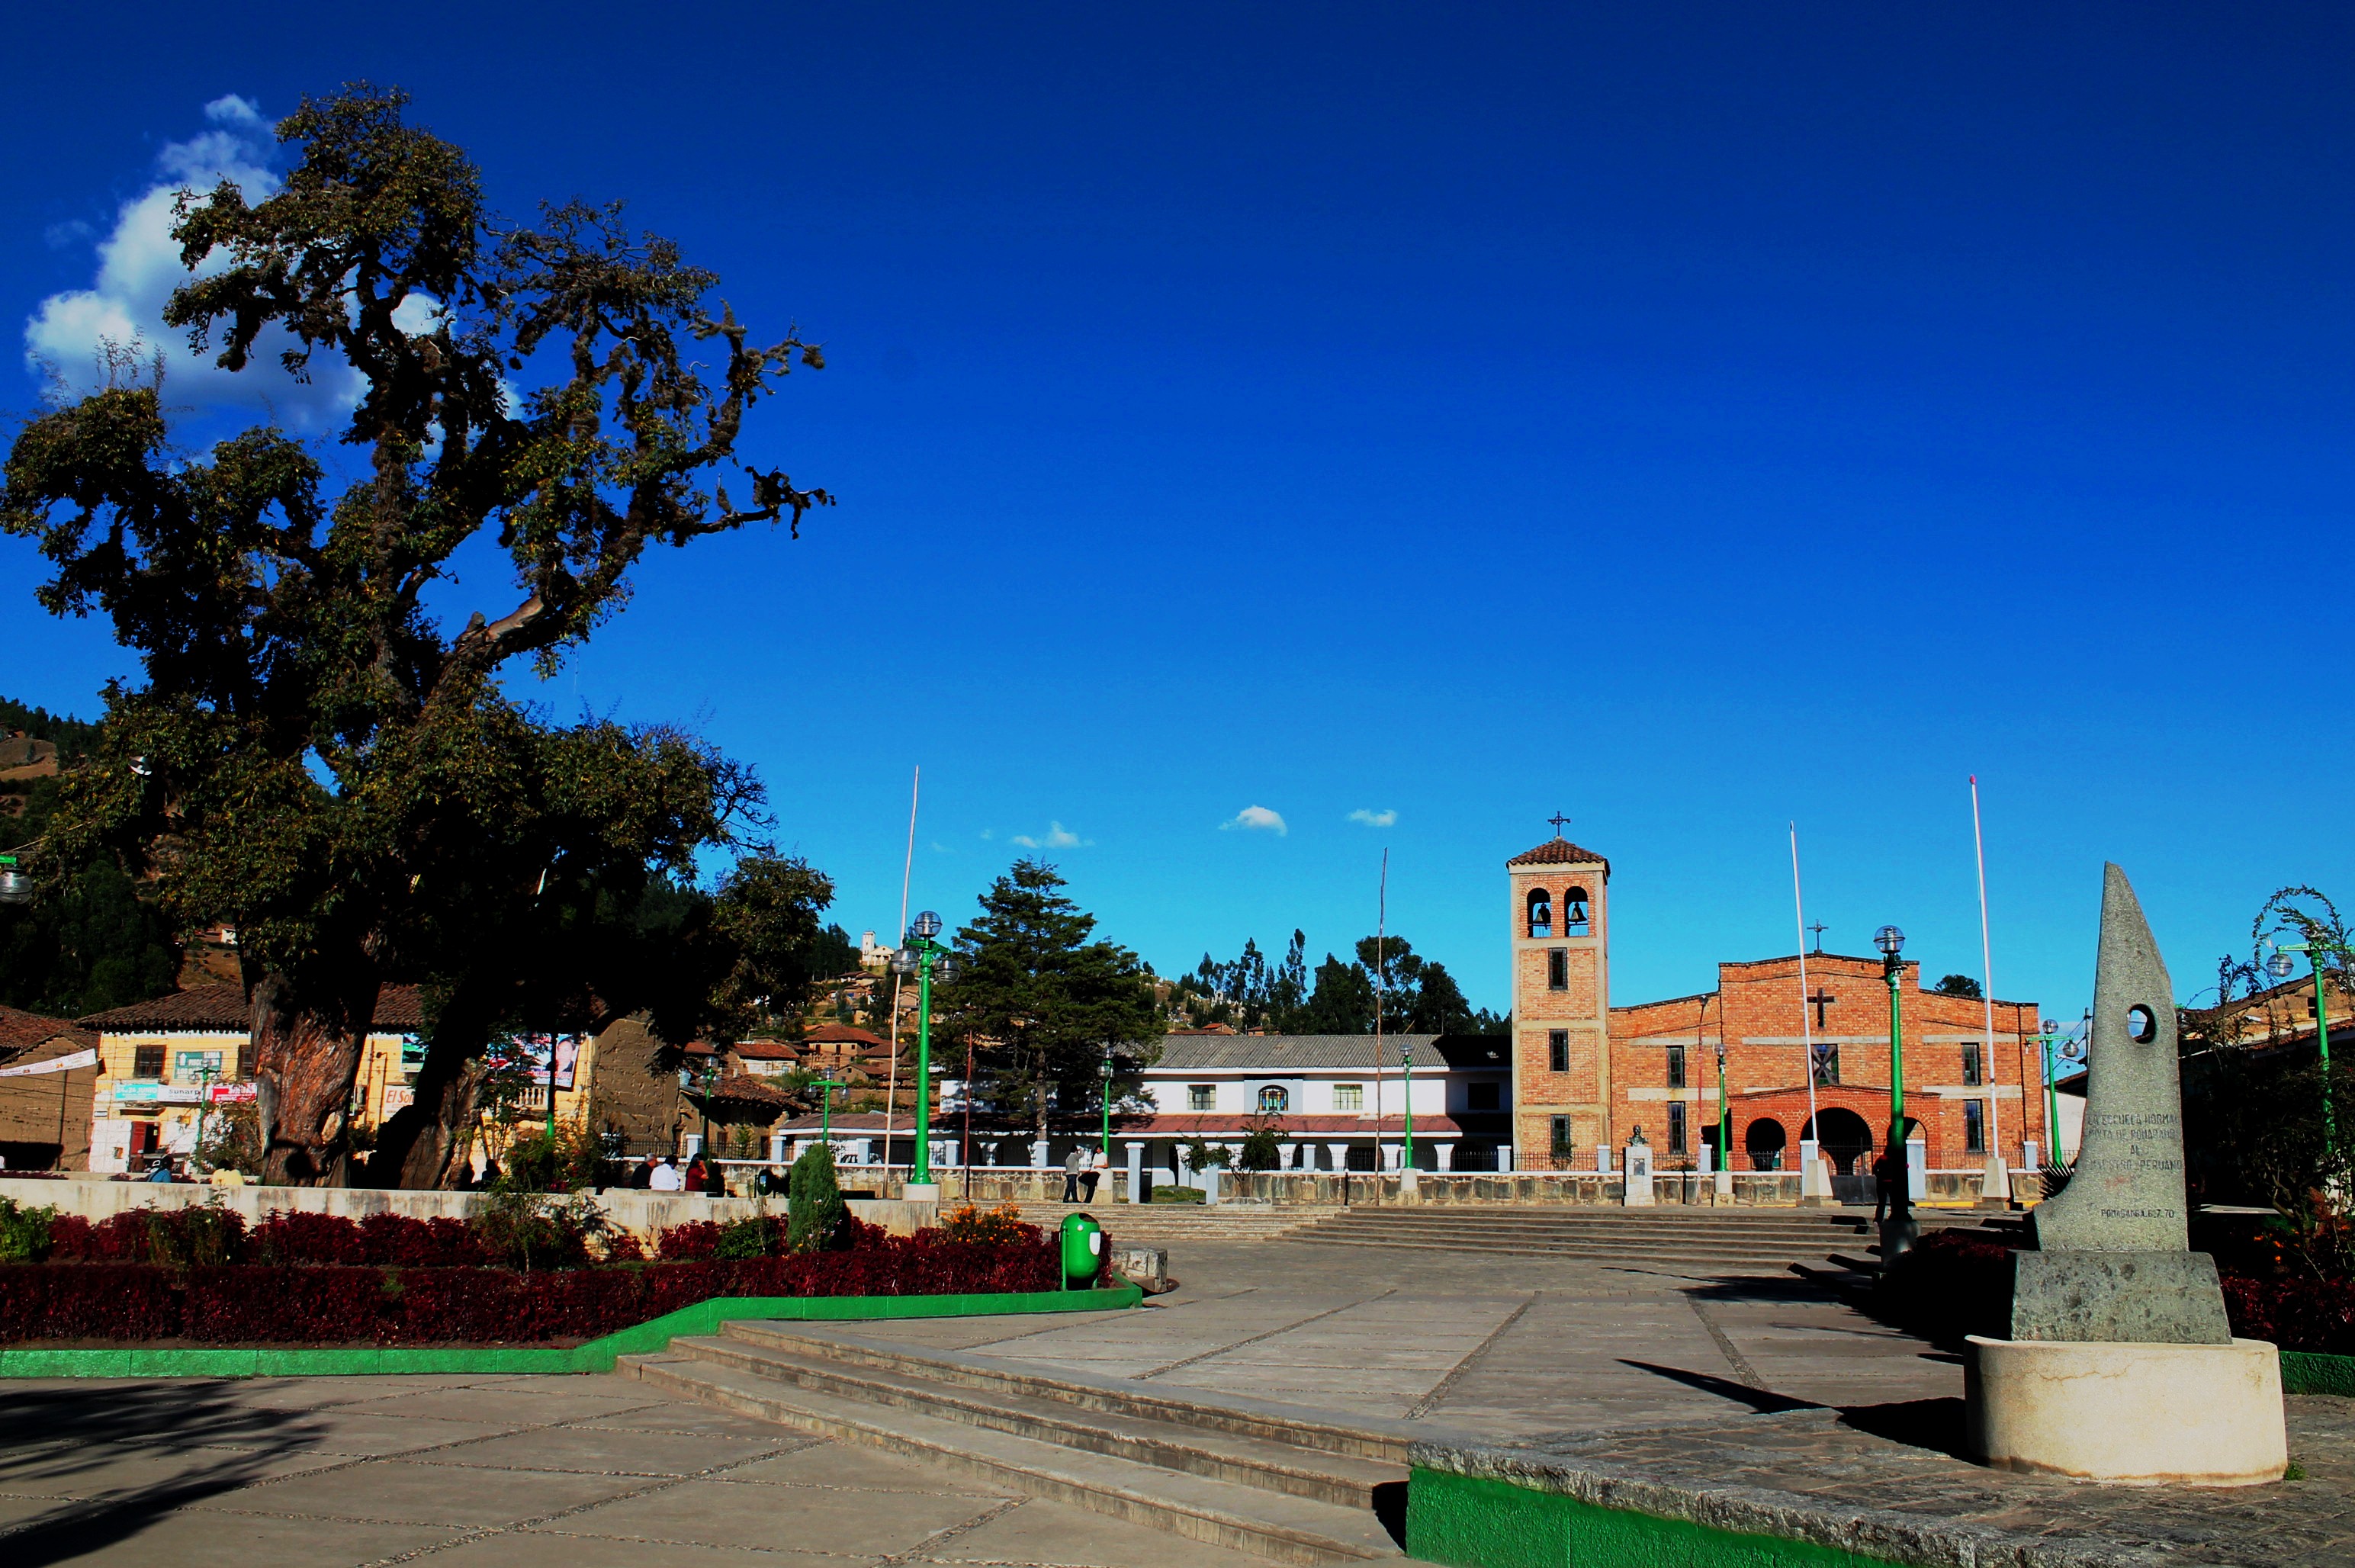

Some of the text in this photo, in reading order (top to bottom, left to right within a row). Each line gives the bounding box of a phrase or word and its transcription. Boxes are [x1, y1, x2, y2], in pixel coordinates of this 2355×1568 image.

[386, 1090, 397, 1104] El
[2101, 1114, 2141, 1125] ESCUELA
[2139, 1159, 2183, 1171] PERUANO
